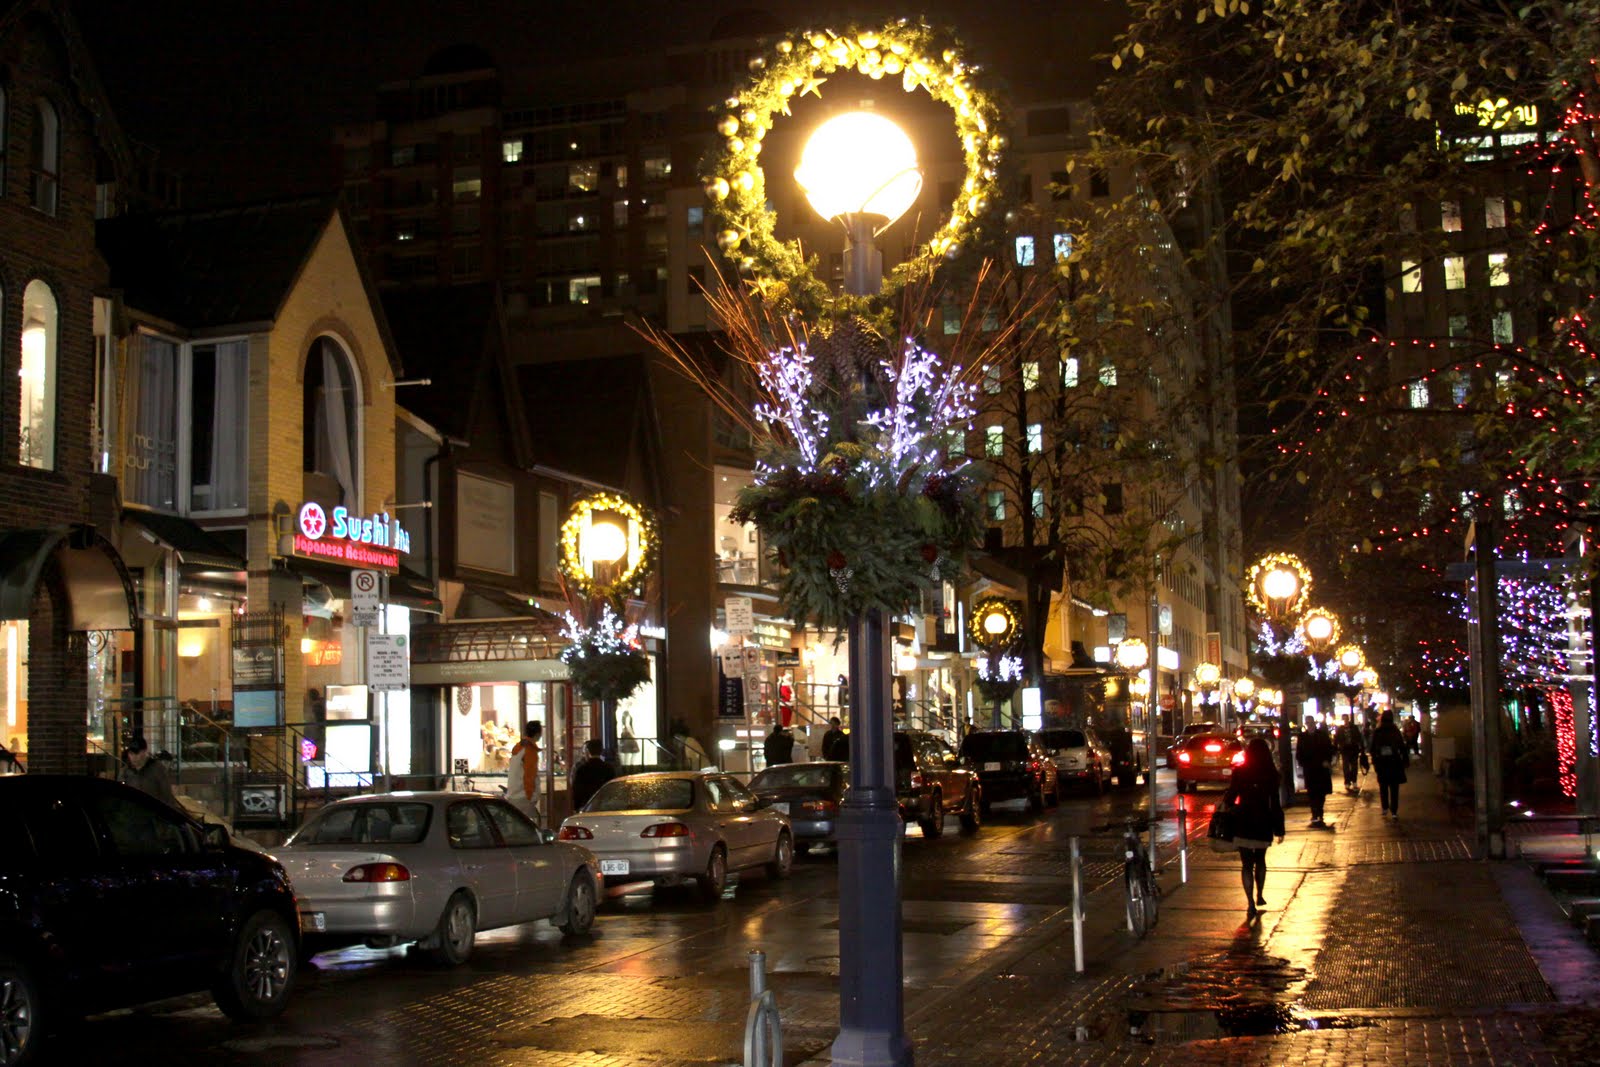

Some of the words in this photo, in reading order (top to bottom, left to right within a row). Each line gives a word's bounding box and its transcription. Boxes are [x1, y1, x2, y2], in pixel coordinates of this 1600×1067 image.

[333, 506, 390, 547] Sushi
[295, 534, 344, 557] Japanese
[345, 543, 398, 568] Restaurant
